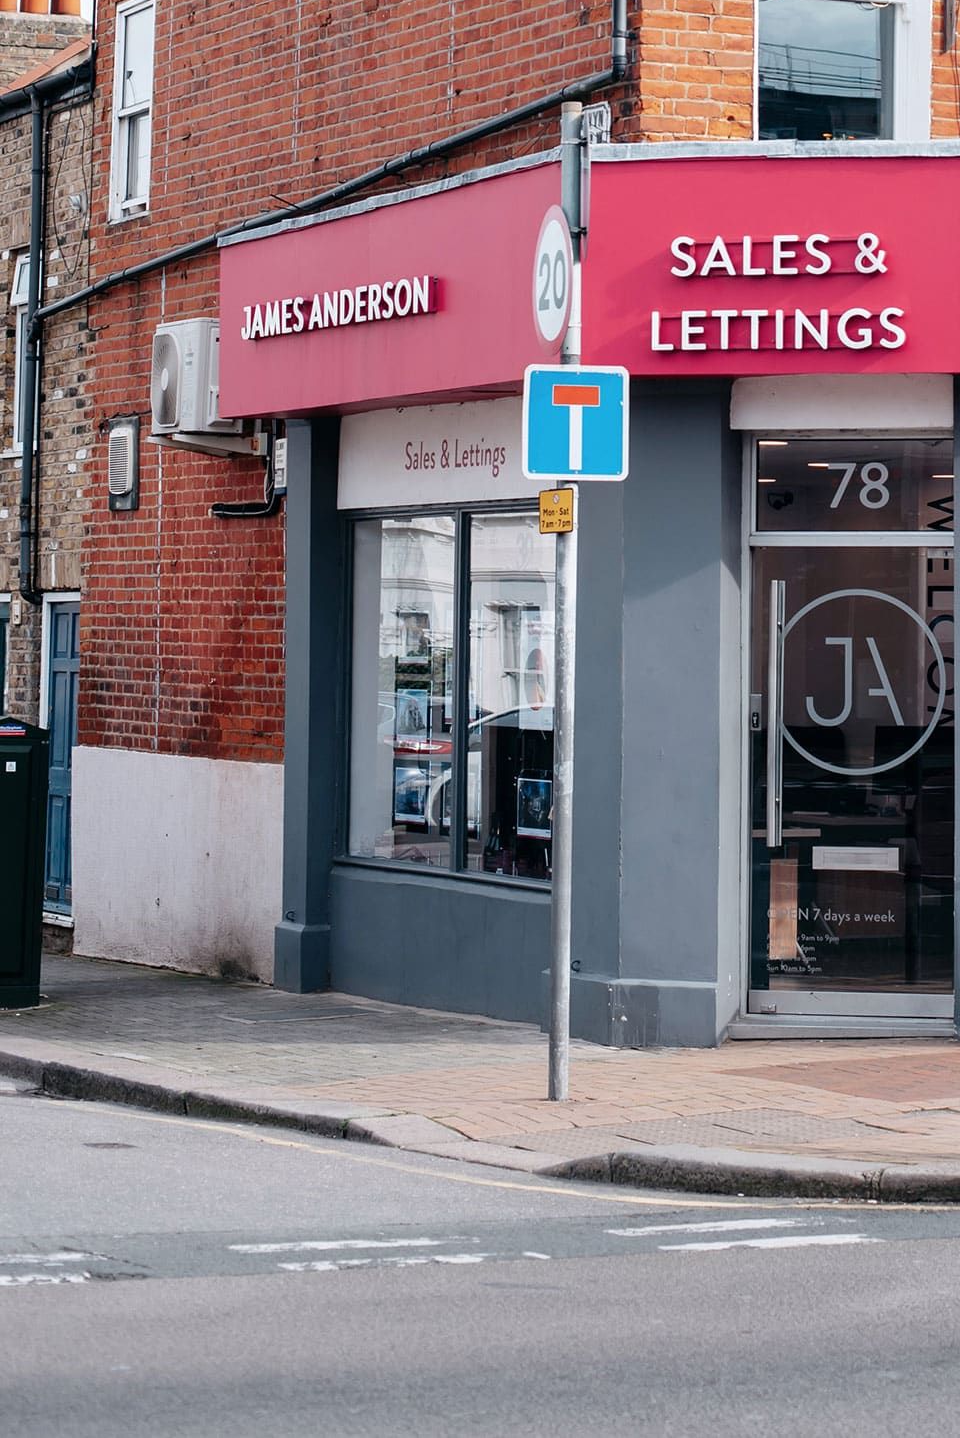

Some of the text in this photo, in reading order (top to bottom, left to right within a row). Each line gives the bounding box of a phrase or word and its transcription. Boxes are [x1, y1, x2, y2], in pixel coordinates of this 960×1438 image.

[670, 232, 888, 278] SALES &
[538, 249, 566, 311] 20
[241, 275, 429, 340] JAMES ANDERSON
[651, 307, 907, 351] LETTINGS
[405, 437, 506, 478] Sales & Lettings
[827, 462, 890, 509] 78
[543, 508, 555, 516] Mon
[559, 507, 569, 516] Sat
[806, 637, 905, 727] JA
[813, 908, 821, 920] 7
[824, 908, 851, 926] days
[854, 913, 861, 921] a
[863, 910, 895, 923] week
[766, 964, 779, 972] Sun
